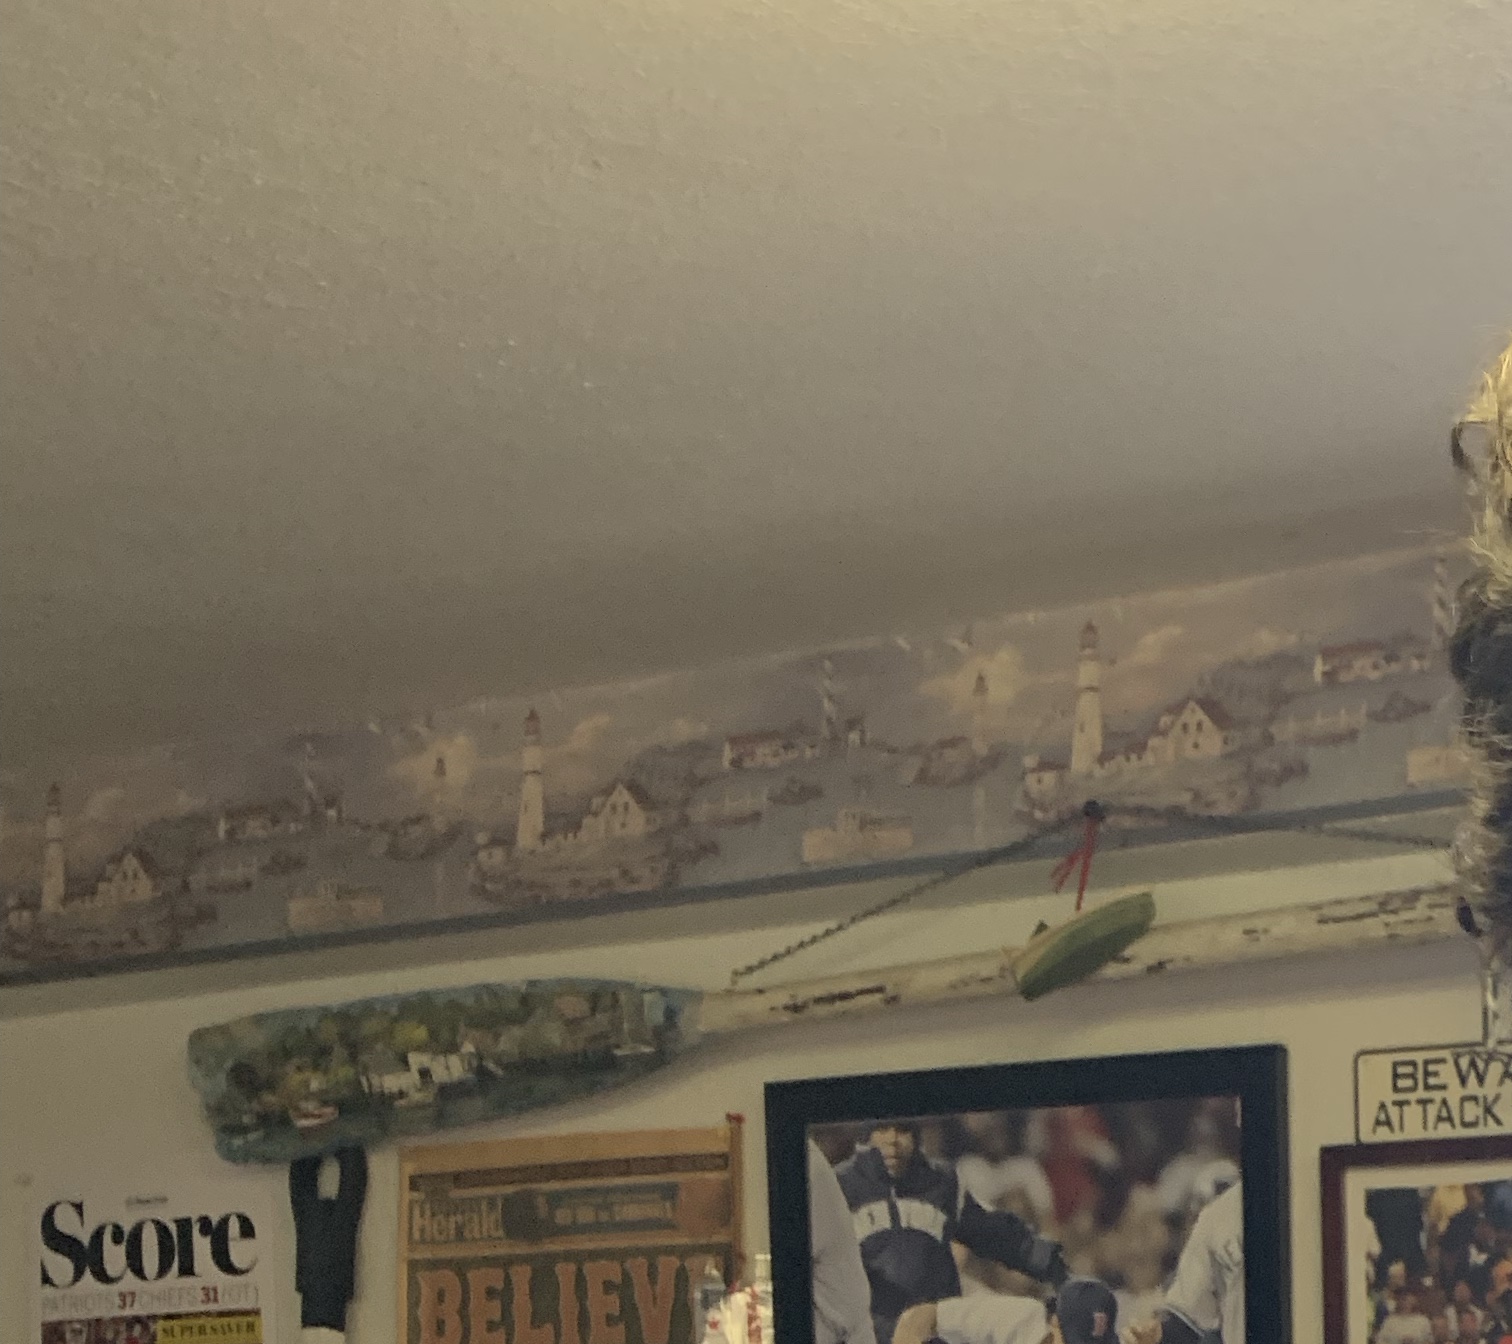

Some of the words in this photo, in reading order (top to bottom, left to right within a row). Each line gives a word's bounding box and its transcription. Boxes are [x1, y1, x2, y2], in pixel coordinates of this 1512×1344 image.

[1371, 1092, 1504, 1135] ATTACK
[411, 1198, 504, 1243] Herald
[40, 1199, 259, 1290] Score
[118, 1291, 136, 1310] 37
[200, 1286, 219, 1304] 31
